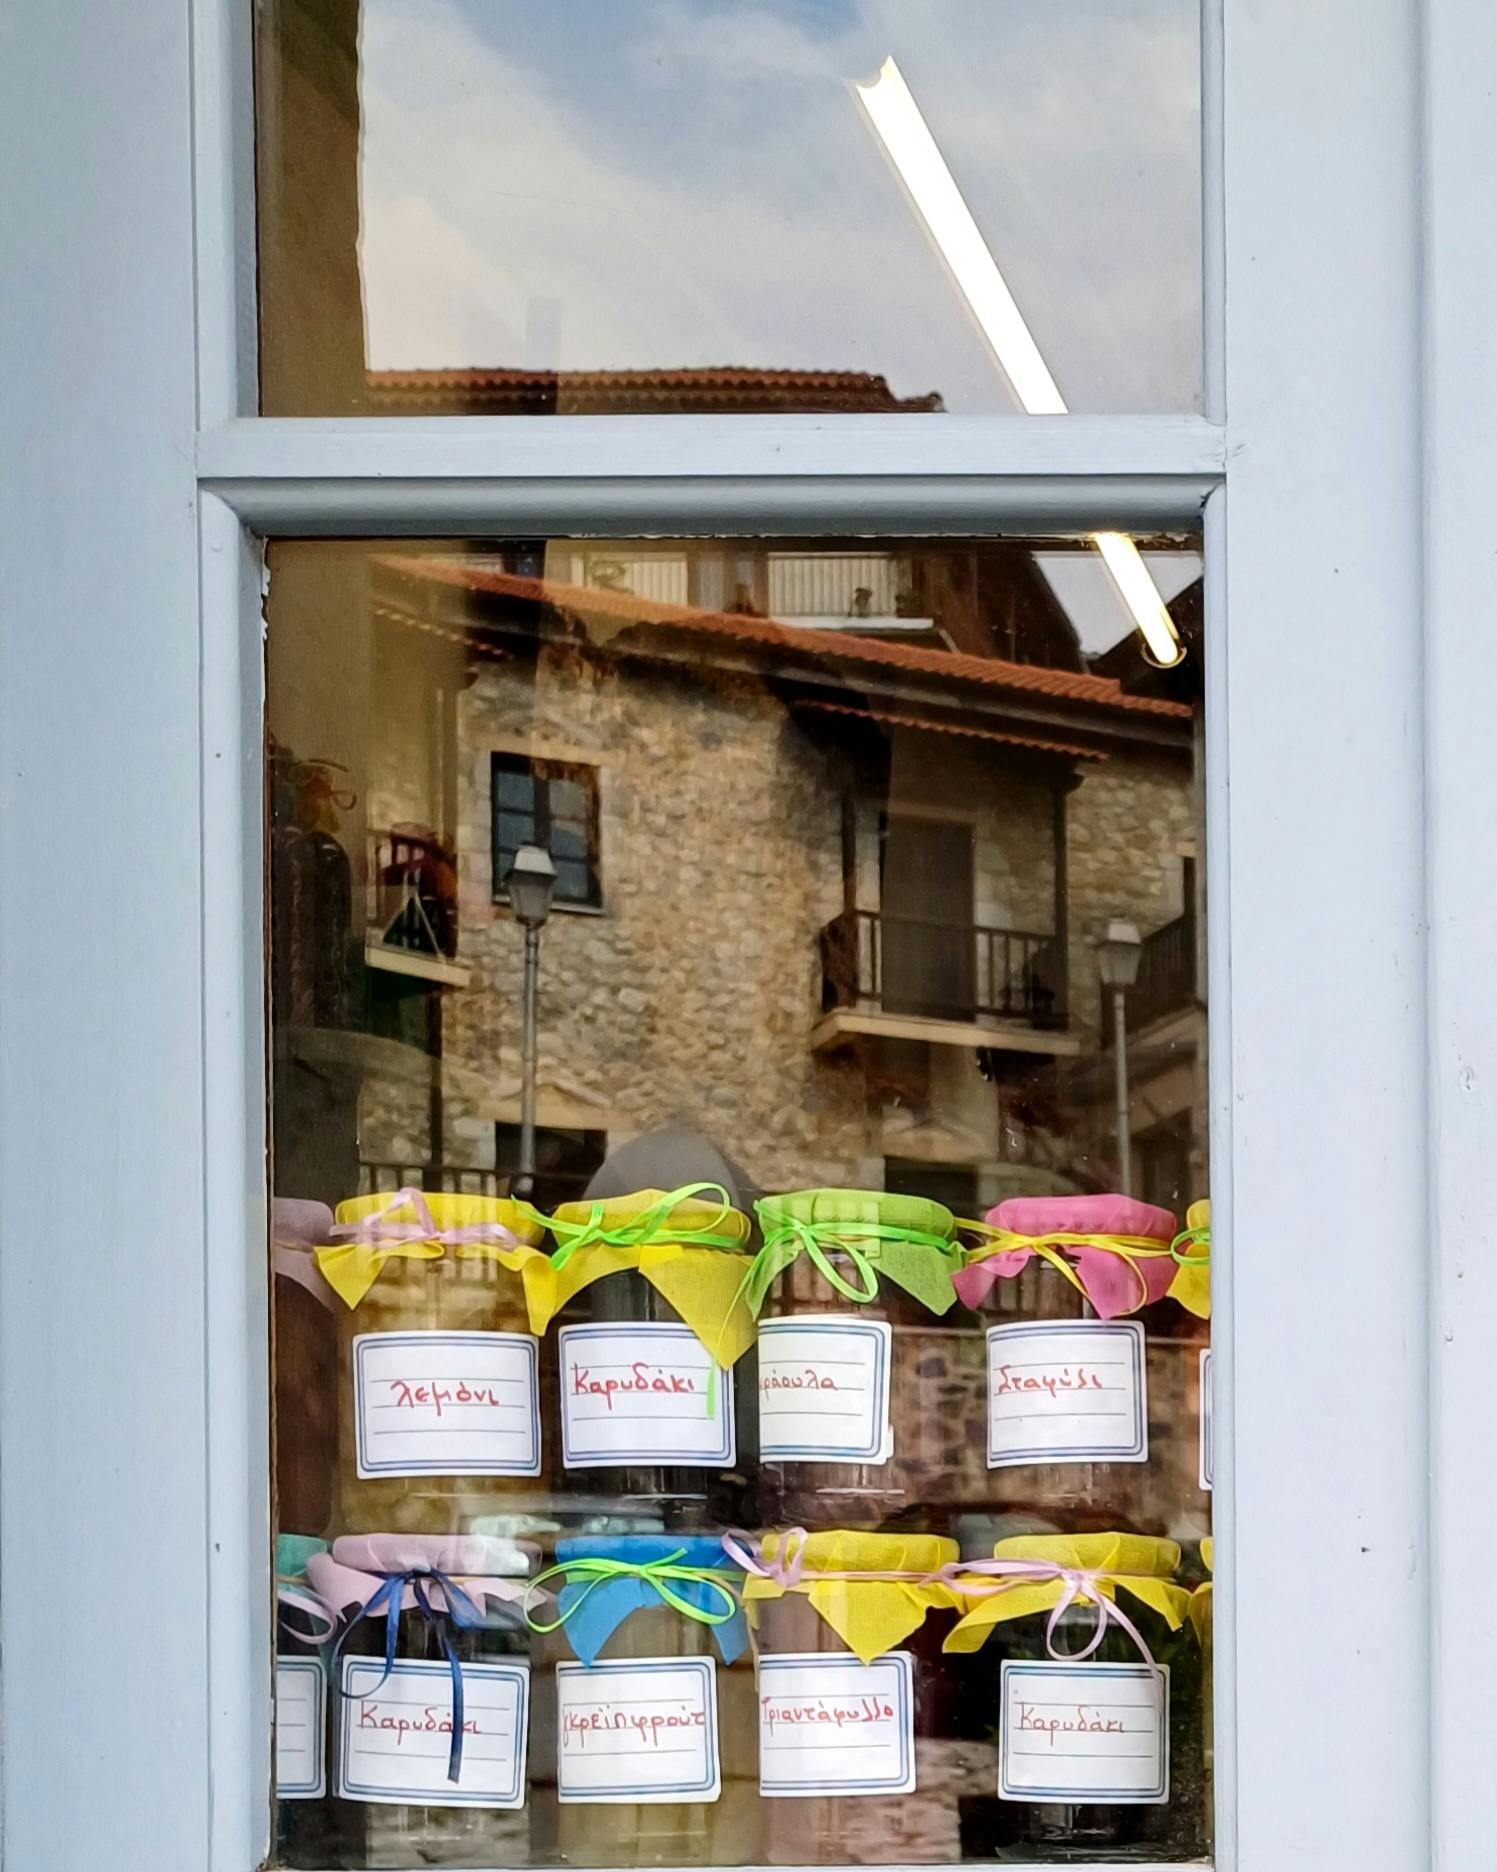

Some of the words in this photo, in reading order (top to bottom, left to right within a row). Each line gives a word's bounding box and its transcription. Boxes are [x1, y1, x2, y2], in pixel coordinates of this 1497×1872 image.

[574, 1362, 694, 1410] Καρυδάκι
[760, 1368, 839, 1401] ράουλα
[1019, 1702, 1127, 1746] Καρυδάκι
